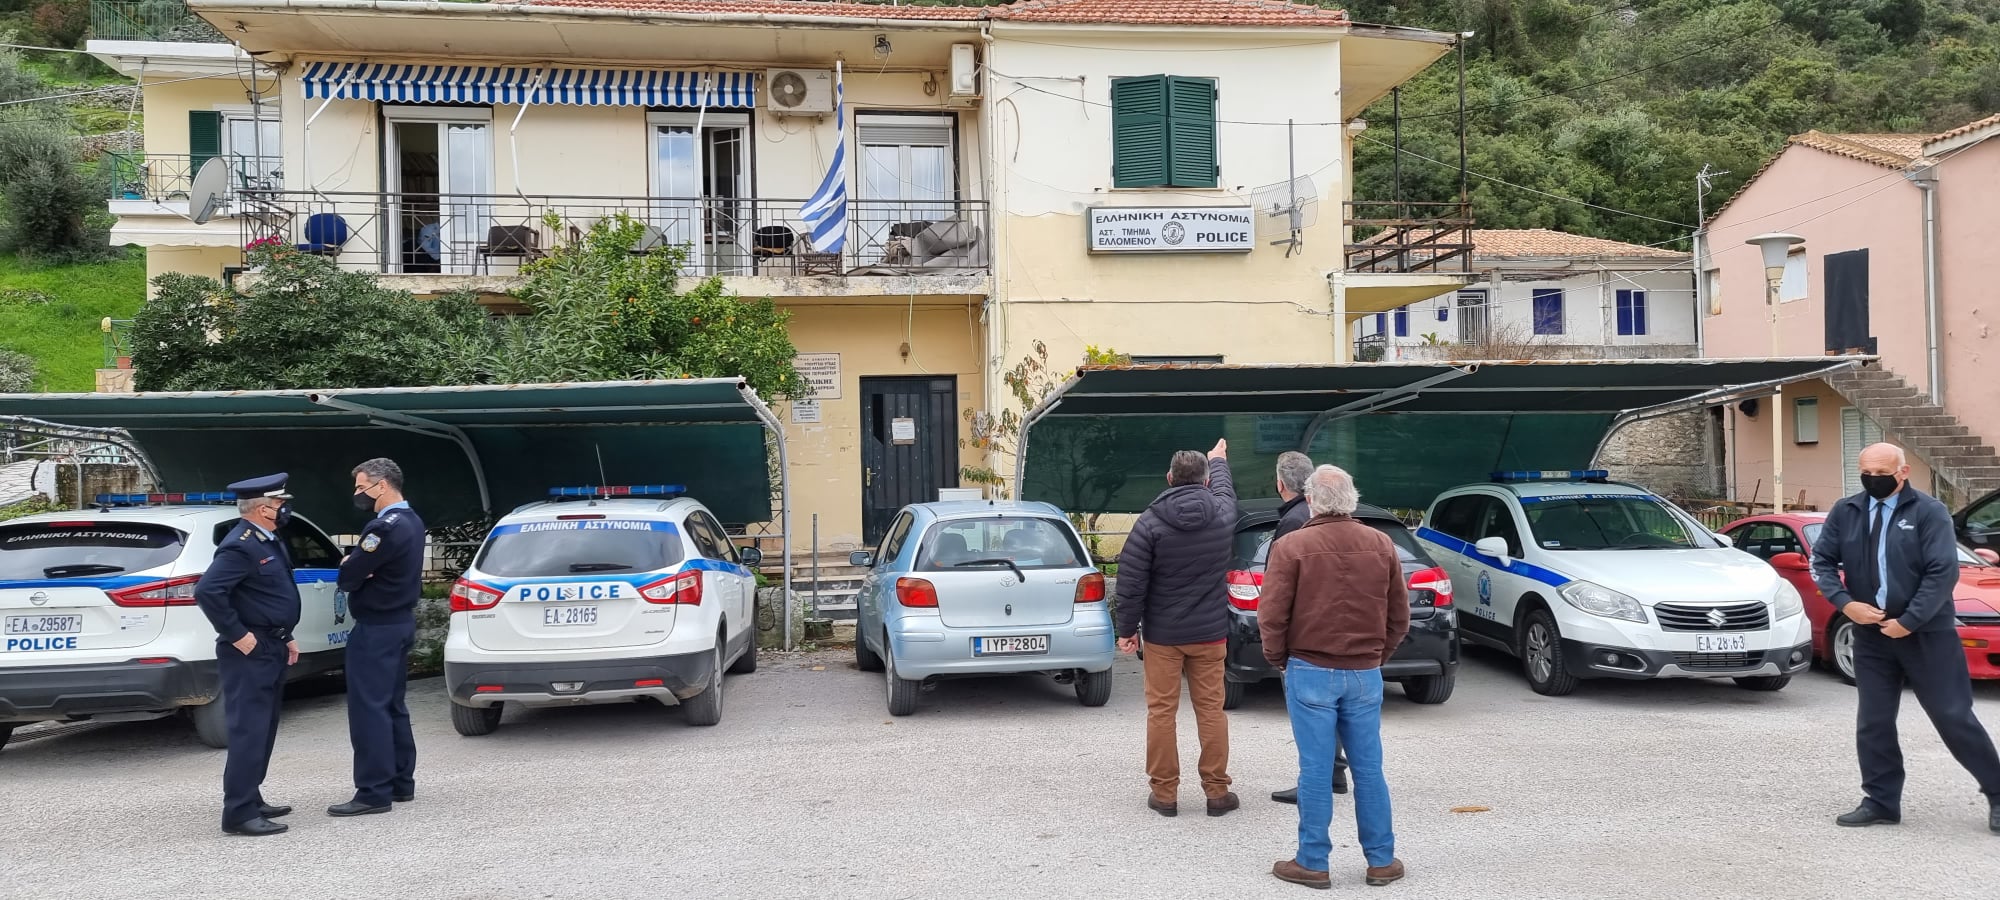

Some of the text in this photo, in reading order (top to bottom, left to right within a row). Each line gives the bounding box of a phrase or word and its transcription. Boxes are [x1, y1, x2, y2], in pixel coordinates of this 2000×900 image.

[1096, 212, 1250, 224] ΕΛΛΗΝΙΚΗ ΑΣΤΥΝΟΜΙΑ
[1122, 228, 1151, 236] ΤΜΗΜΑ
[1196, 232, 1248, 243] POLICE
[1099, 237, 1157, 246] ΕΛΛΟΜΕΝΟΥ
[520, 521, 651, 533] ΕΛΛΗΝΙΚΗ ΑΣΤΥΝΟΜΙΑ
[7, 531, 148, 543] ΕΛΛΗΝΙΚΗ ΑΣΤΥΝΟΜΙΑ
[520, 585, 620, 602] POLICE
[566, 607, 597, 623] 28165
[40, 616, 74, 631] 29587
[7, 637, 77, 651] POLICE
